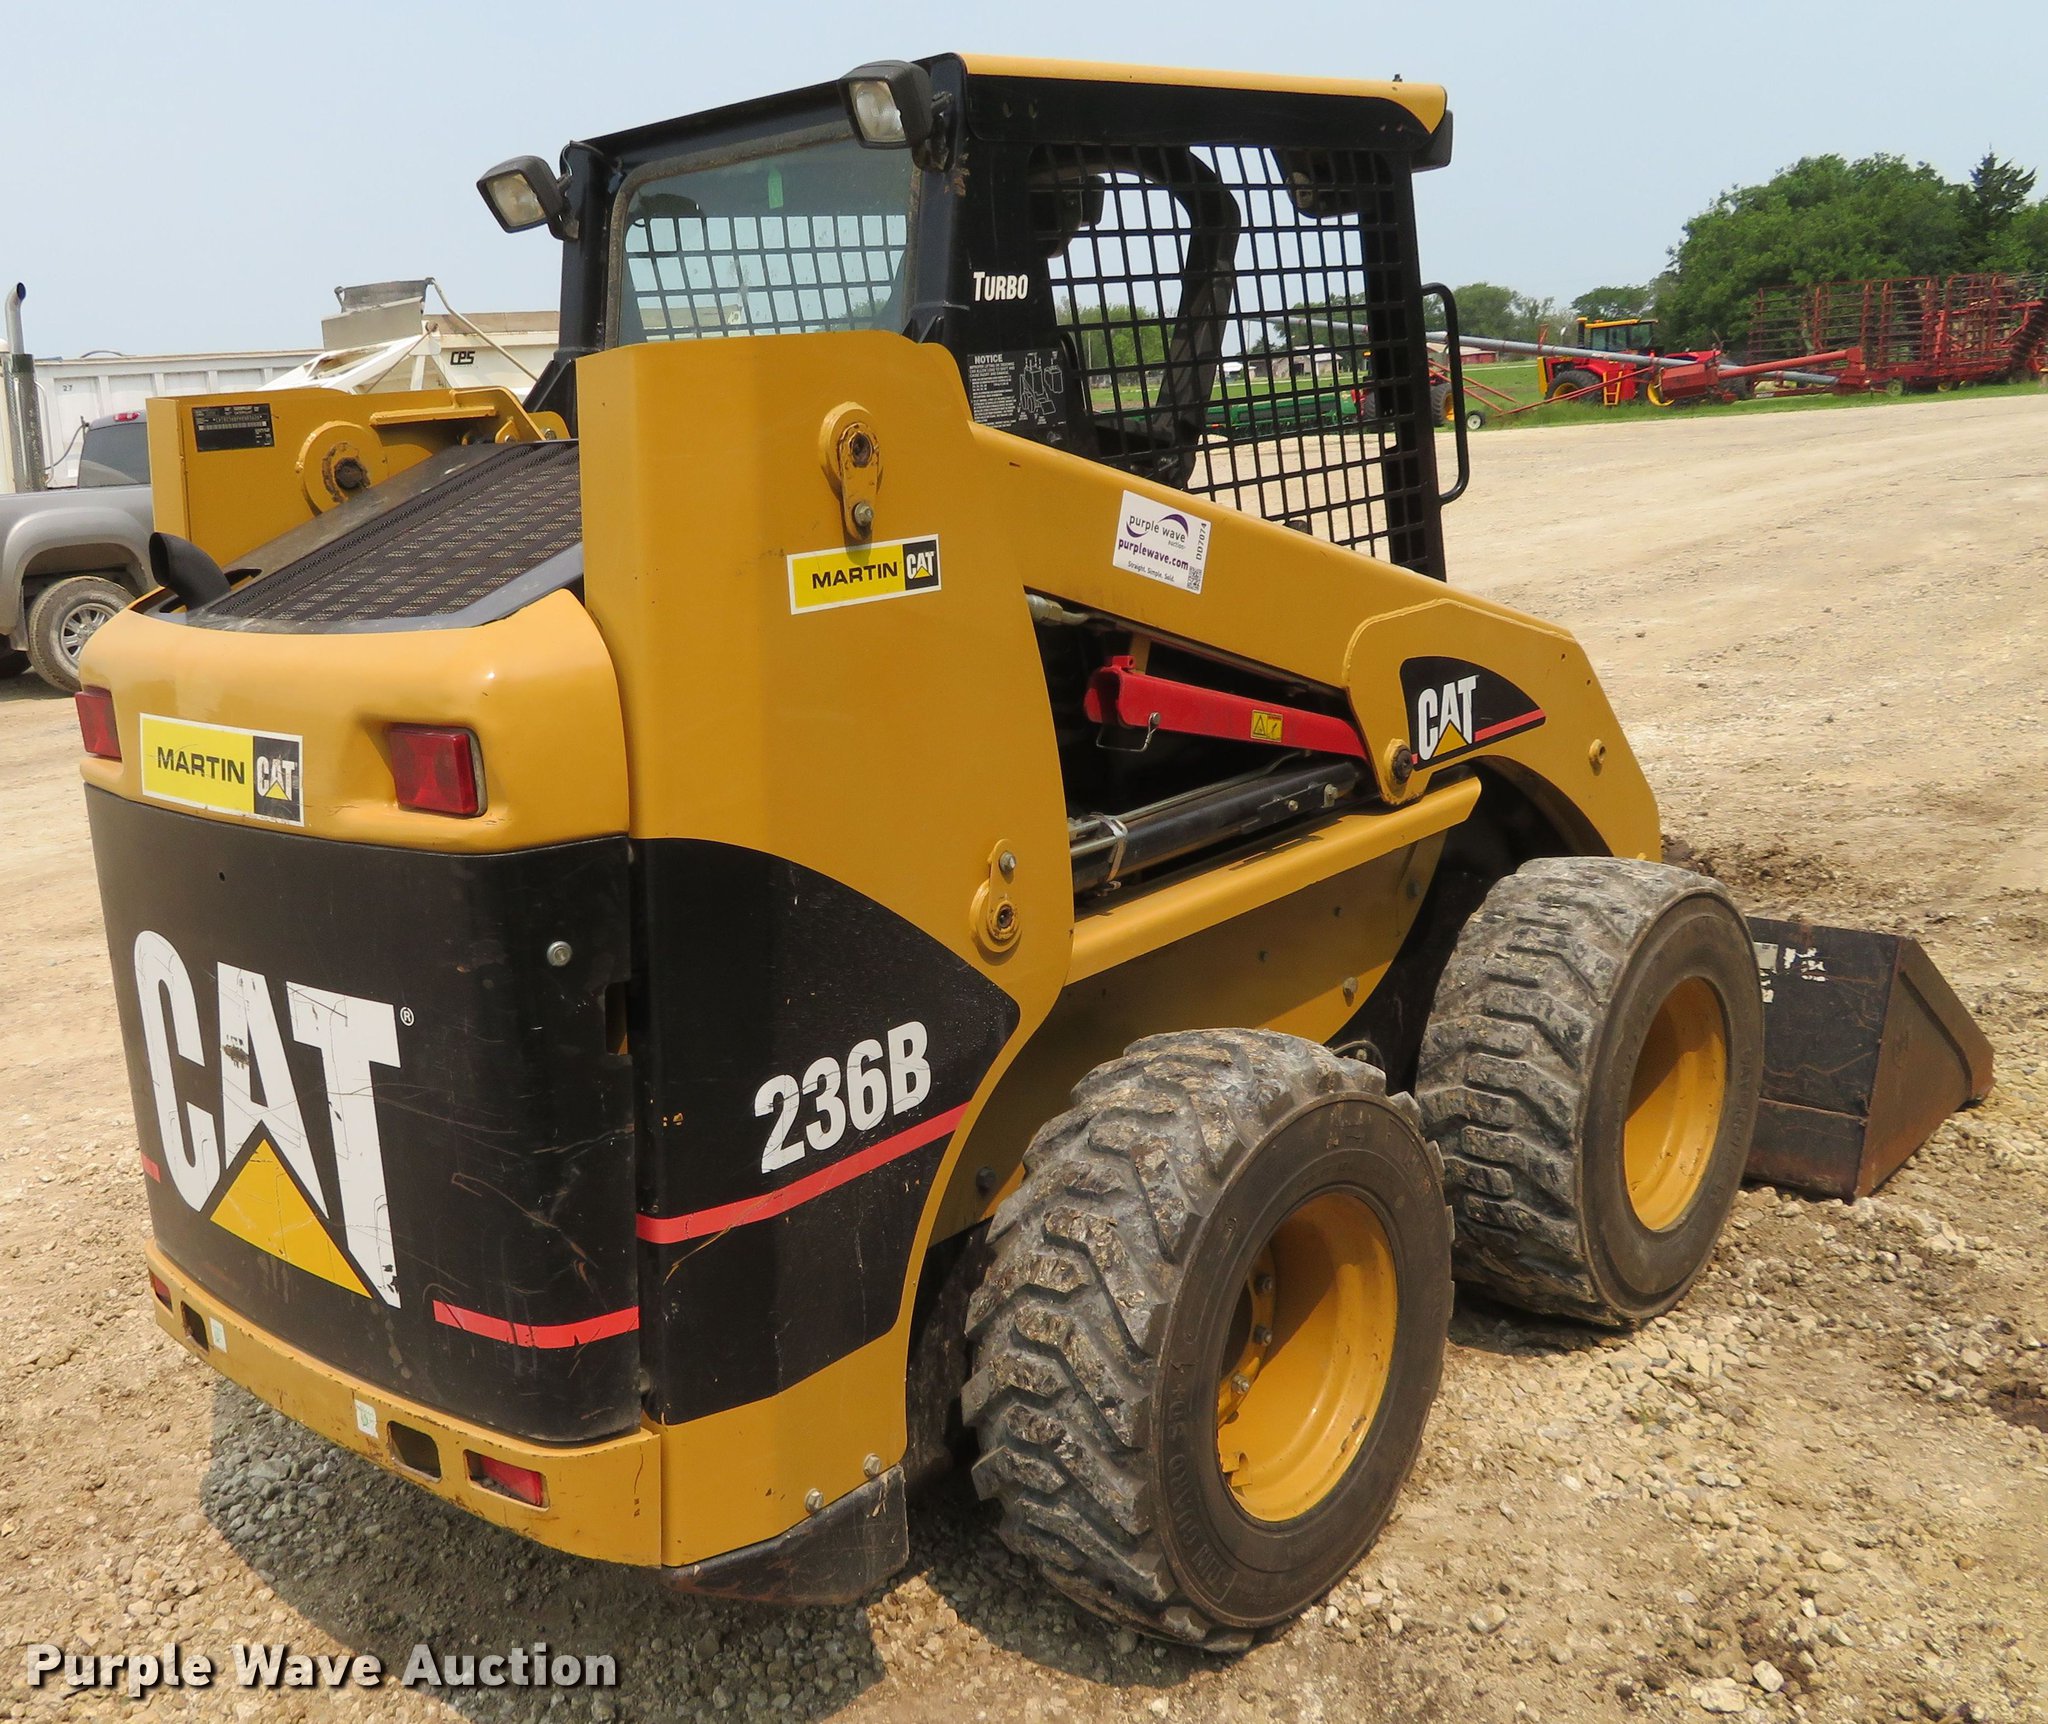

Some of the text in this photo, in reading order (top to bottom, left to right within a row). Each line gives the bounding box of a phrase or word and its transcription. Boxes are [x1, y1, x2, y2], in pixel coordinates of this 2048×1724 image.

[973, 271, 1029, 302] TURBO
[450, 350, 475, 365] CPS
[974, 354, 1004, 365] NOTICE
[62, 384, 73, 392] 27
[1129, 515, 1186, 543] purple wave
[1195, 522, 1207, 561] DD7074
[812, 550, 935, 590] MARTIN CAT
[1118, 538, 1189, 571] purplewave.com
[1417, 674, 1478, 761] CAT
[157, 746, 296, 802] MARTIN CAT
[753, 1020, 932, 1175] 236B
